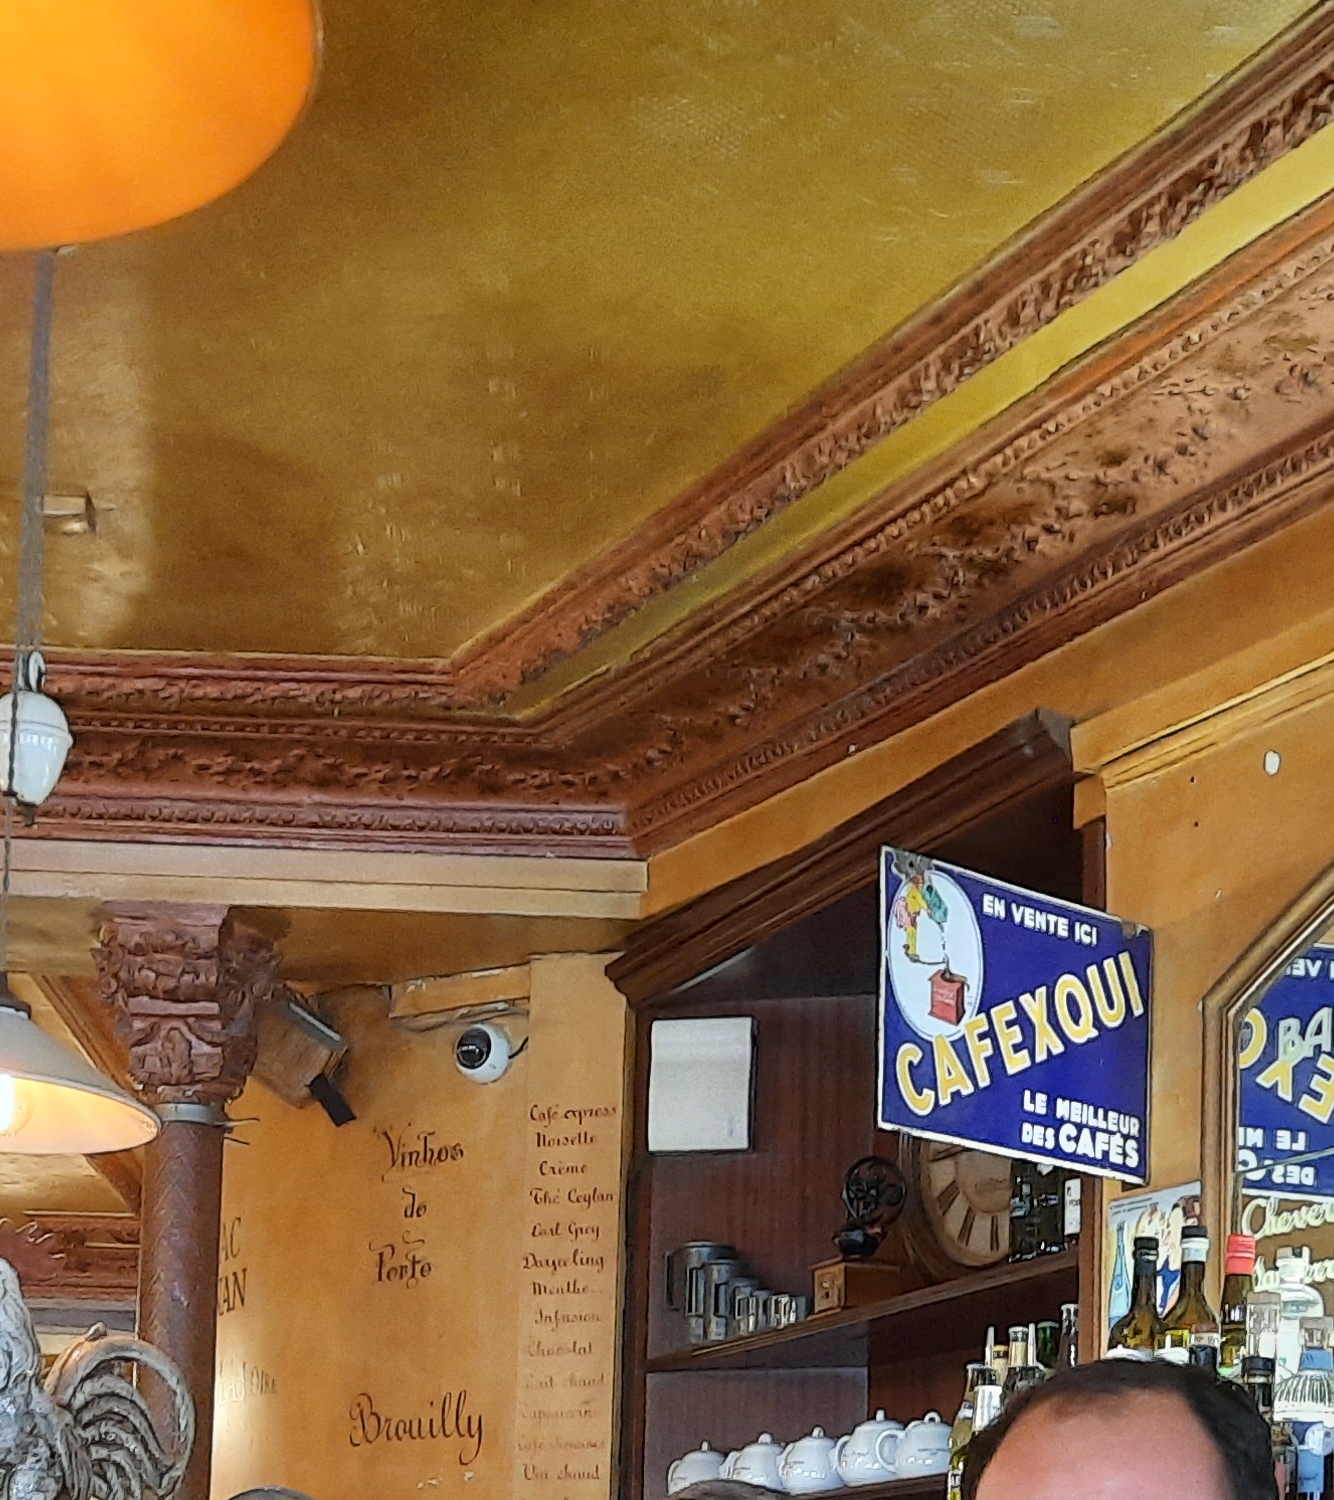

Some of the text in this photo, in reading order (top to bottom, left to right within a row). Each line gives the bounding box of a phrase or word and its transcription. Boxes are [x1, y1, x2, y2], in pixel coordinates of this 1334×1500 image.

[983, 893, 1098, 947] EN VENTE ICI
[896, 951, 1144, 1117] CAFEXQUI
[530, 1103, 617, 1128] Café express
[1023, 1090, 1141, 1138] LE MEILLEUR
[375, 1123, 465, 1178] Vinhos
[1021, 1123, 1055, 1149] DES
[539, 1160, 588, 1176] Crème
[567, 1187, 614, 1209] Ceylan
[568, 1221, 600, 1241] Grey
[349, 1389, 483, 1466] Brouilly
